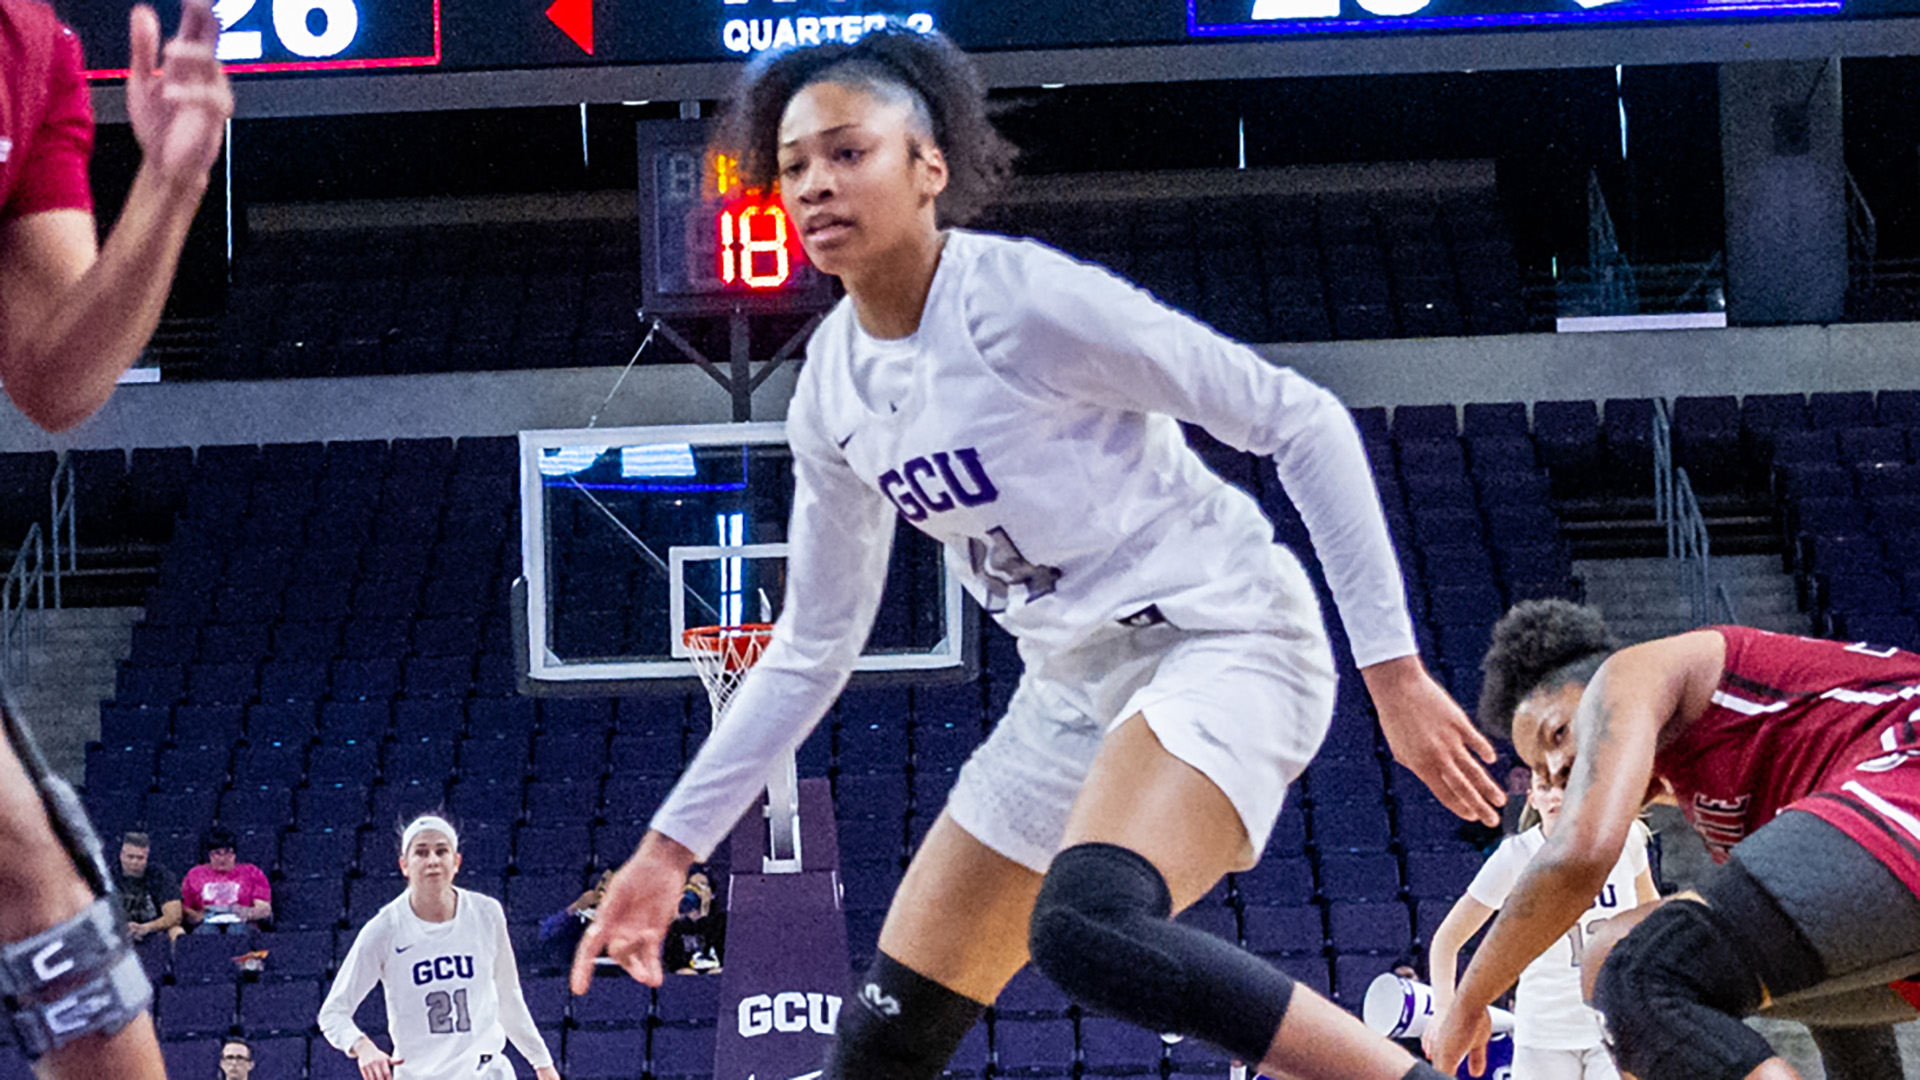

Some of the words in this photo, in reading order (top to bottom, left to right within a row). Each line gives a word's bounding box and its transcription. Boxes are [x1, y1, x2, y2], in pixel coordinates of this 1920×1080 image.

[720, 205, 789, 288] 18
[877, 447, 999, 523] GCU
[412, 955, 474, 986] GCU
[425, 988, 472, 1034] 21
[738, 991, 843, 1038] GCU
